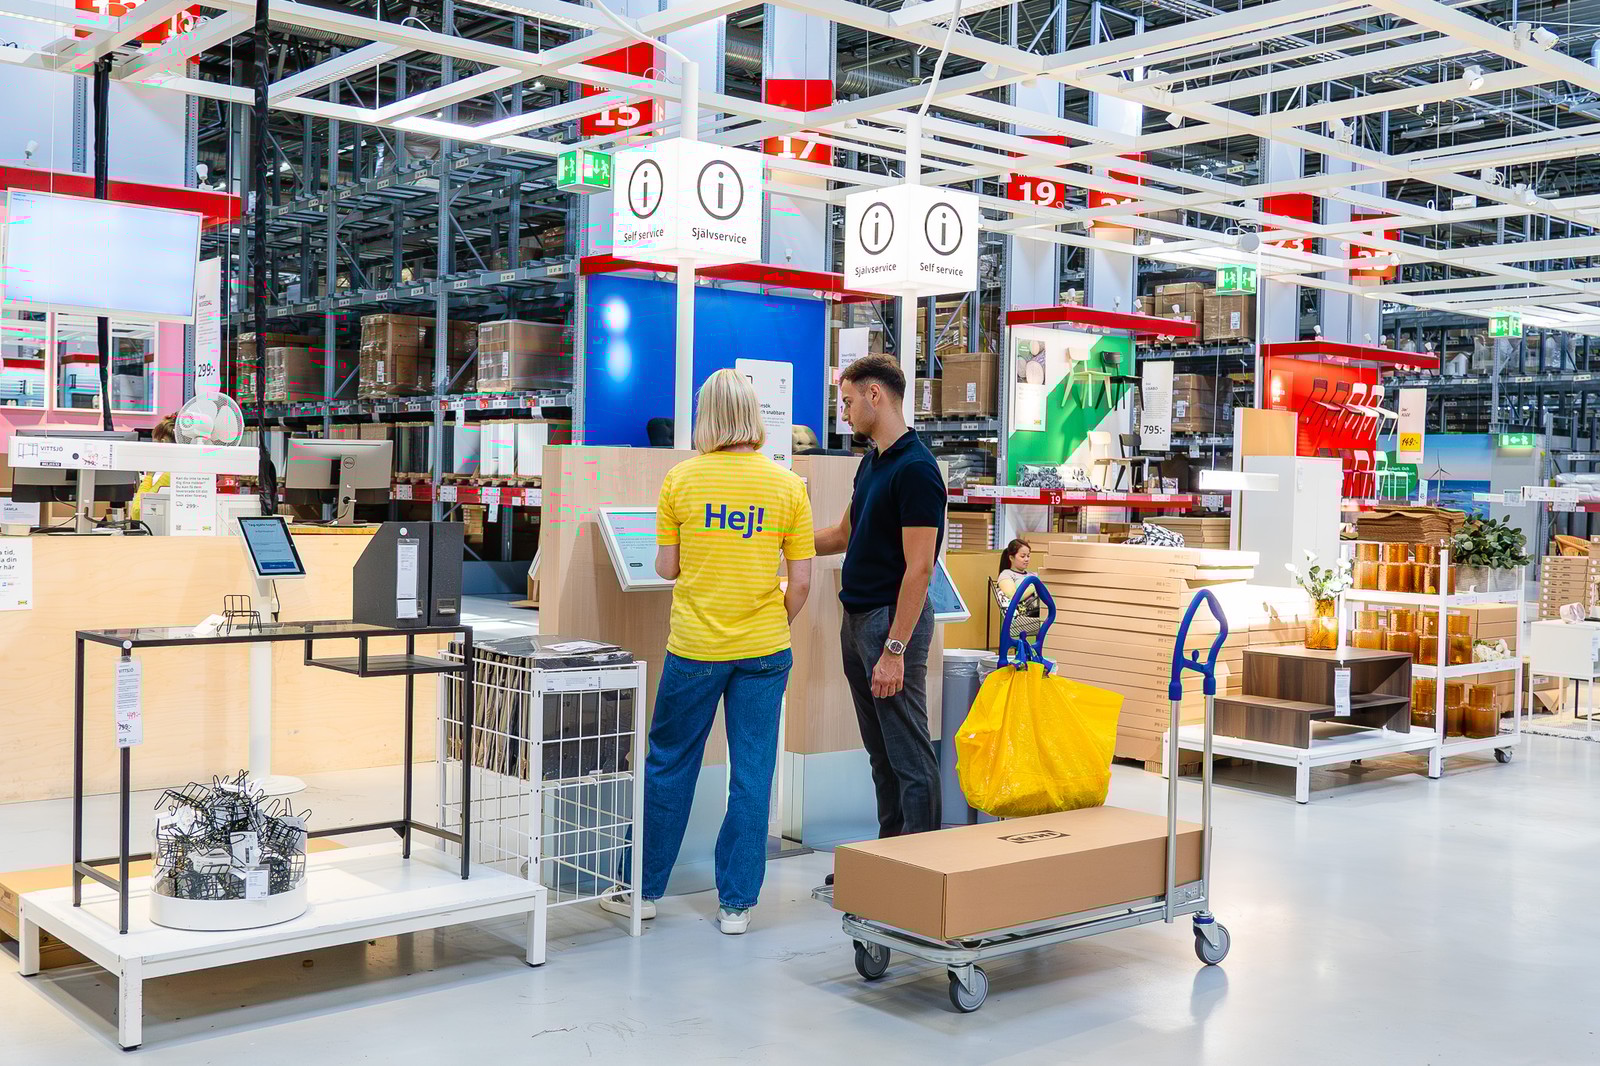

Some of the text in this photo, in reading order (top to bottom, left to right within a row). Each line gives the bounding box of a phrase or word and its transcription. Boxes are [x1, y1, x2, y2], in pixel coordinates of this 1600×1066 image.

[595, 105, 640, 127] 15
[1019, 181, 1056, 206] 19
[624, 228, 664, 243] Self service
[692, 227, 747, 244] Självservice
[855, 263, 897, 278] Självservice
[919, 262, 964, 277] Self service
[1143, 425, 1165, 435] 795:-
[1401, 437, 1419, 447] 149:-
[1050, 496, 1061, 505] 19
[705, 503, 765, 539] Hej!
